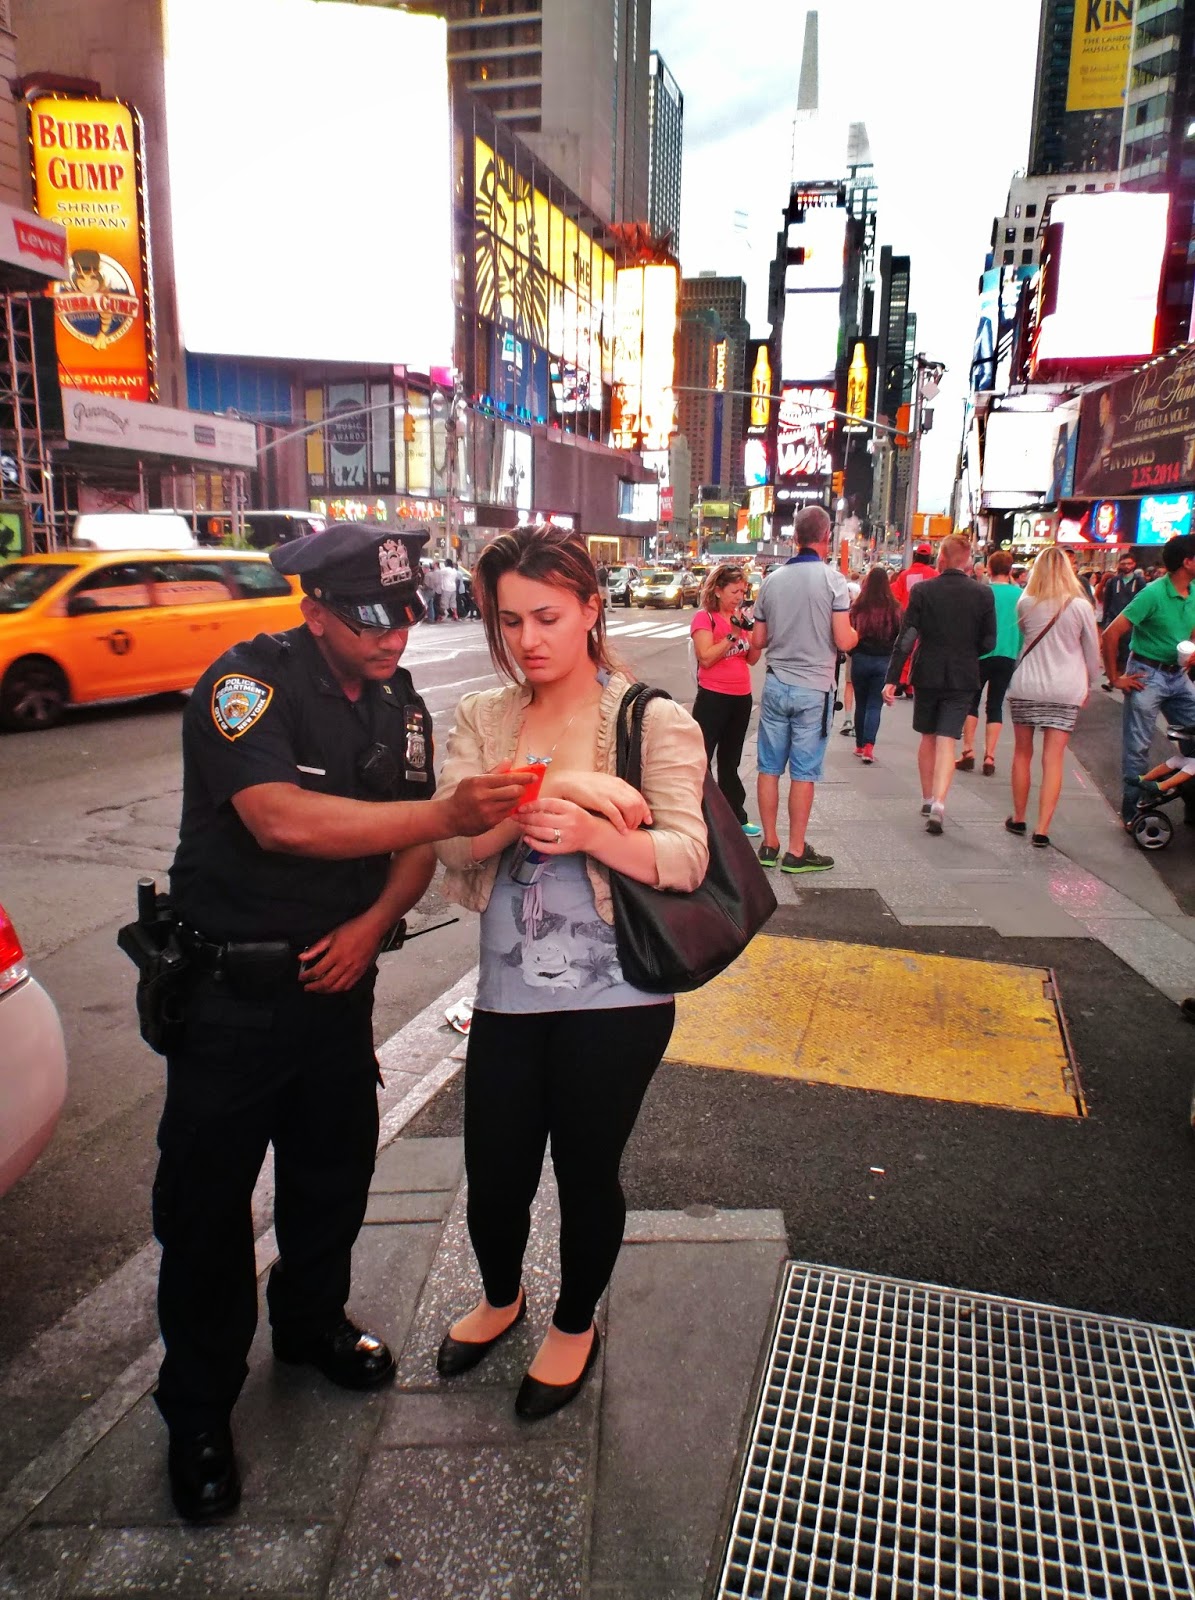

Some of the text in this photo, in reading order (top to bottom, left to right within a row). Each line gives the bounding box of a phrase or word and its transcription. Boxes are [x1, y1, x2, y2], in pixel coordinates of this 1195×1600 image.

[38, 114, 129, 151] BUBBA
[48, 157, 124, 191] GUMP
[57, 202, 120, 214] SHRIMP
[54, 296, 138, 314] BUBBA GUMP
[335, 422, 362, 431] MUSIC
[1134, 411, 1168, 432] FORMULA
[333, 432, 366, 441] AWARDS
[311, 474, 324, 487] SUN
[333, 465, 365, 487] 8.24
[216, 684, 267, 699] DEPARTMENT
[224, 678, 256, 687] POLICE
[214, 699, 267, 731] CITY OF NEW YORK
